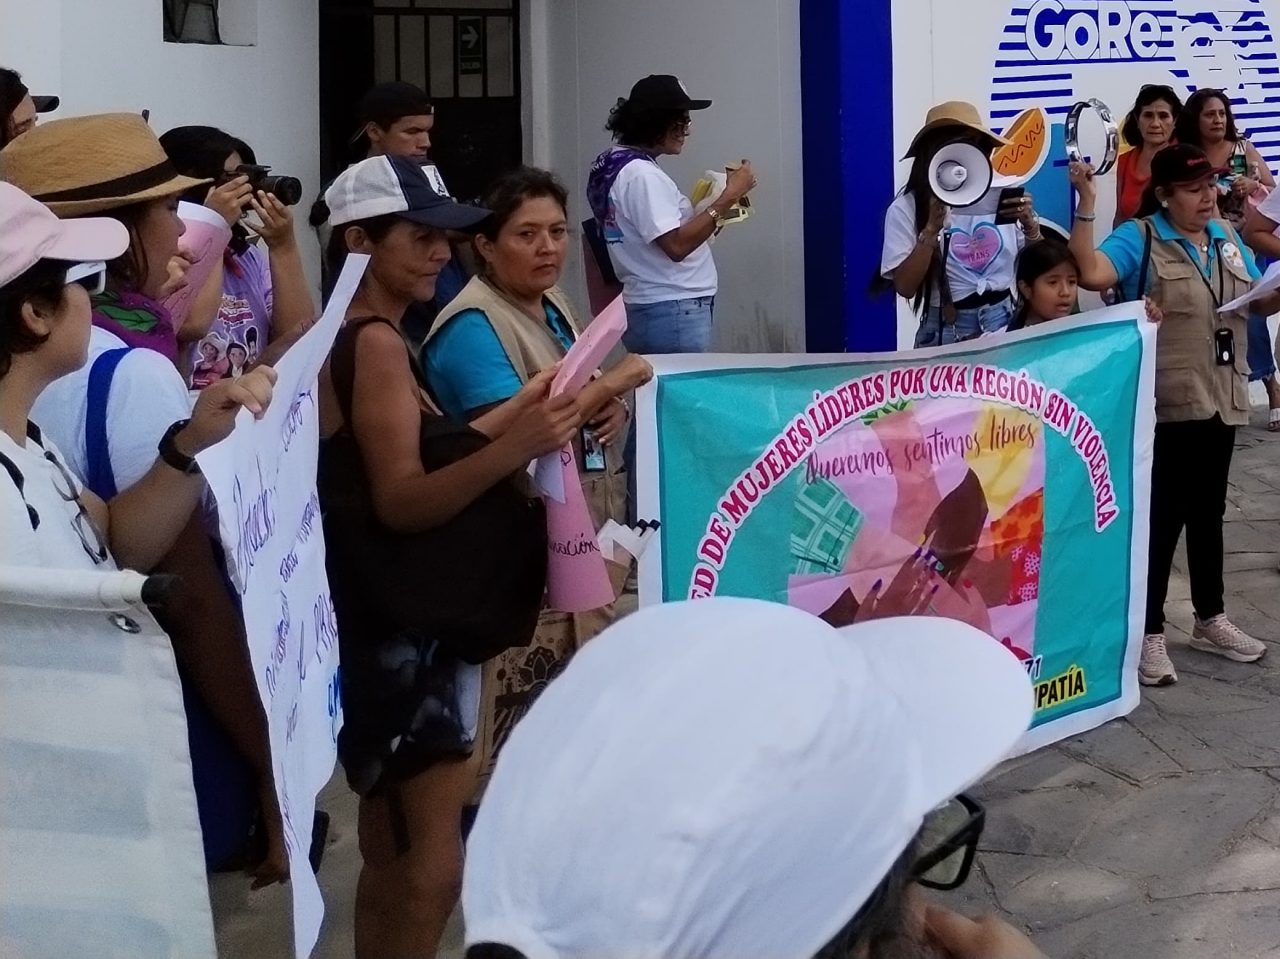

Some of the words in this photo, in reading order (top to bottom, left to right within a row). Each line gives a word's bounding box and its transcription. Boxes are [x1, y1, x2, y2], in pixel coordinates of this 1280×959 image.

[701, 518, 732, 565] DE
[721, 419, 813, 524] MUJERES
[809, 373, 884, 437] LÍDERES
[890, 367, 927, 399] POR
[930, 365, 968, 393] UNA
[973, 367, 1044, 411] REGIÓN
[1044, 393, 1075, 431] SIN
[1074, 416, 1117, 528] VIOLENCIA
[806, 447, 894, 486] Queremos
[990, 415, 1035, 451] libres
